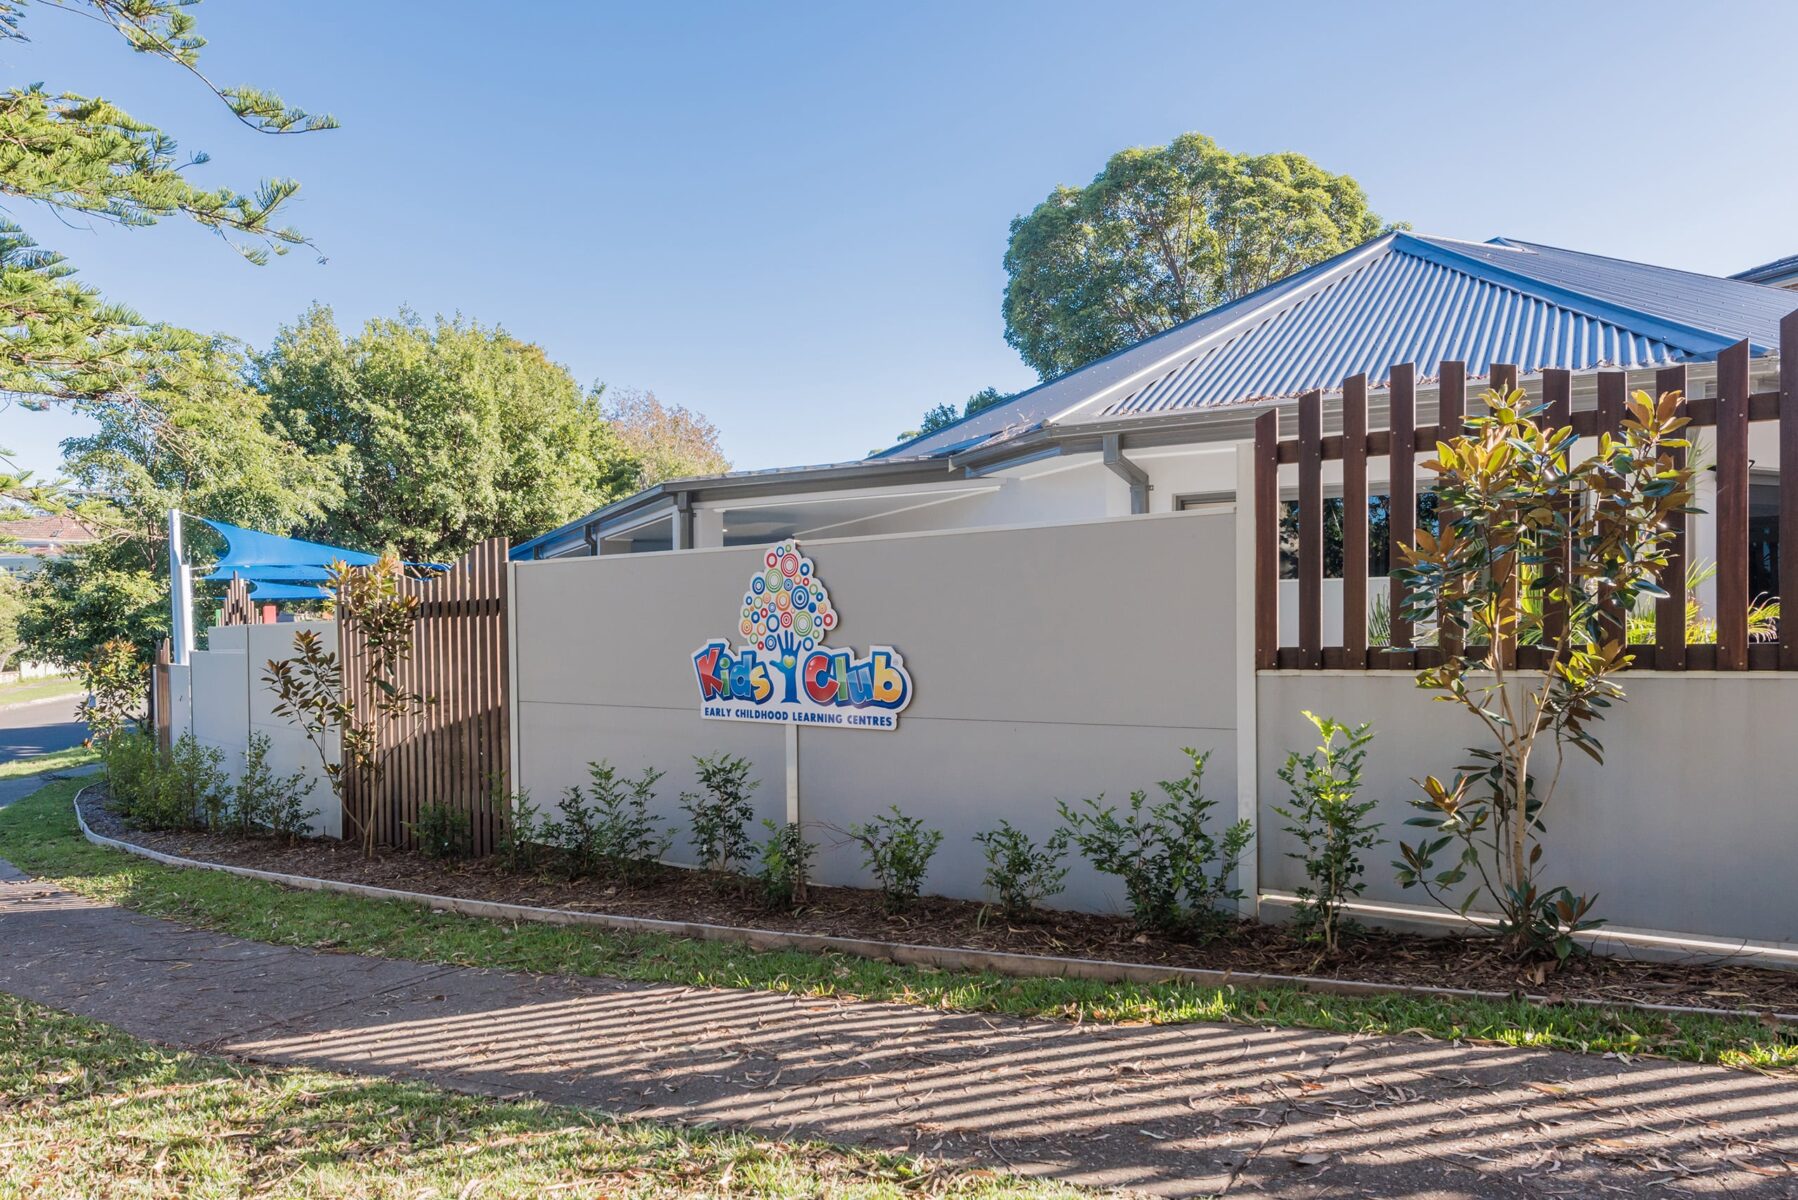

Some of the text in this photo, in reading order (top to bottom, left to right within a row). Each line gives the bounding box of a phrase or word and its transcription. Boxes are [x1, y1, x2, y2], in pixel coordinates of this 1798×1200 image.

[695, 644, 906, 707] Kids Club
[704, 707, 893, 727] EARLY CHILDHOOD LEARNING CENTRES
